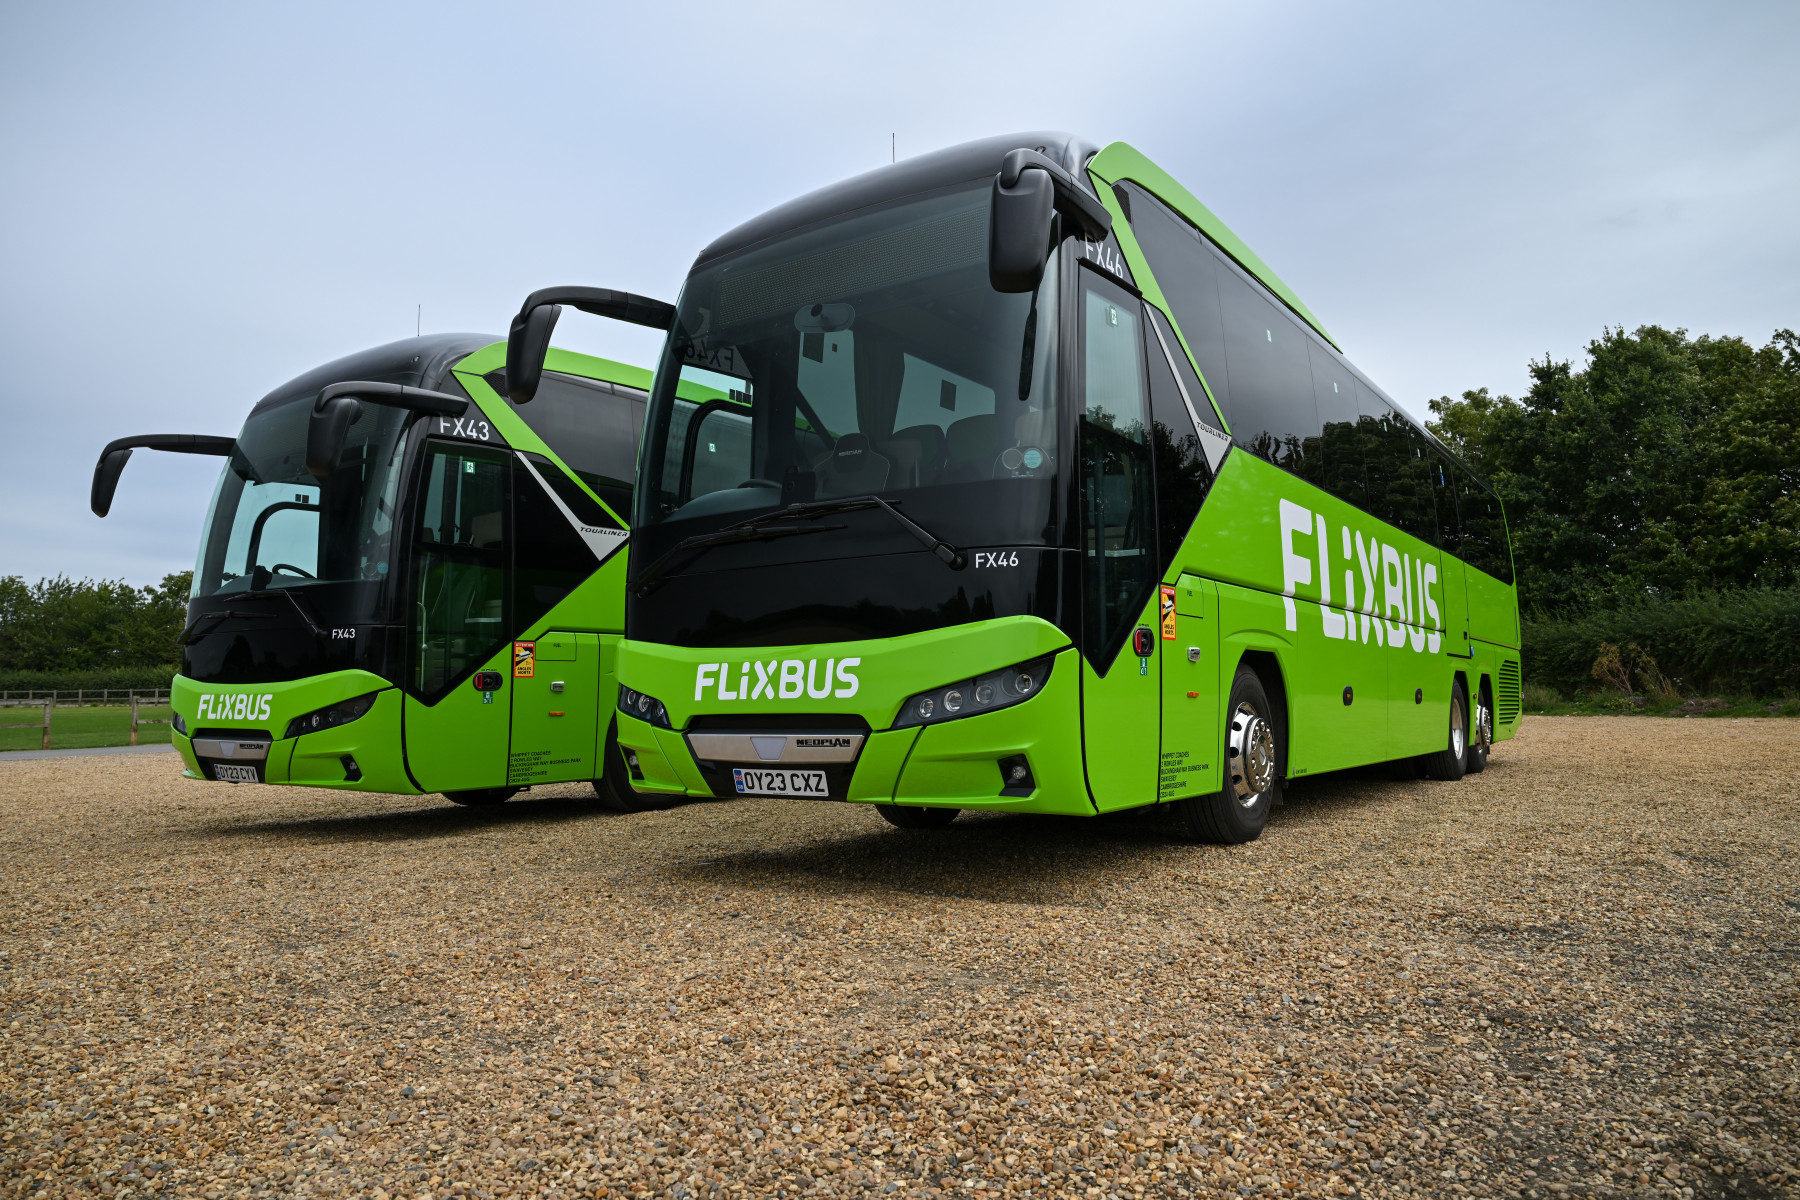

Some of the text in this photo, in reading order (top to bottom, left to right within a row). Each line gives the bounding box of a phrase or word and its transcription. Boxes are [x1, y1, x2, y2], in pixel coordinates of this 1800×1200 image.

[1085, 233, 1123, 279] FX46
[440, 417, 489, 440] FX43
[1196, 421, 1229, 442] TOURLINER
[580, 526, 628, 537] TOURLINER
[975, 551, 1019, 569] FX46
[332, 628, 356, 639] FX43
[797, 738, 850, 748] NEOPLAN
[220, 766, 257, 781] OY23 CYV
[744, 771, 826, 793] OY23 CXZ
